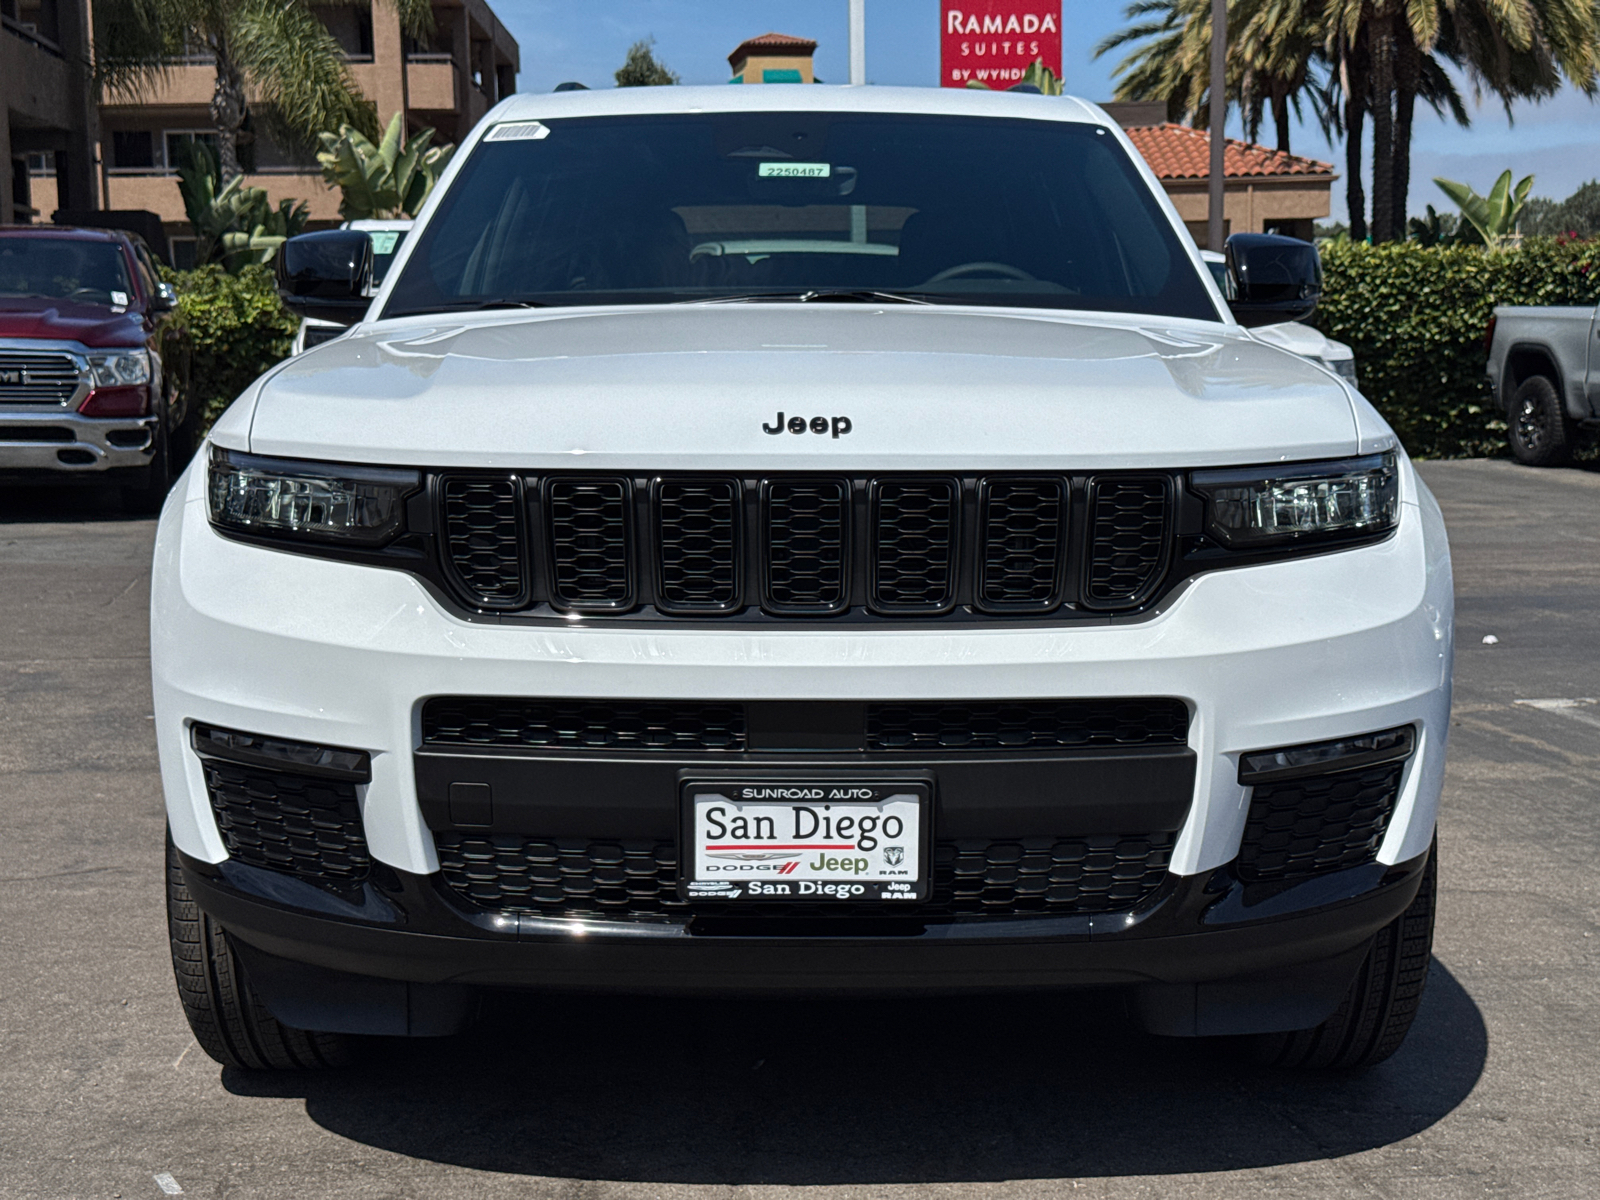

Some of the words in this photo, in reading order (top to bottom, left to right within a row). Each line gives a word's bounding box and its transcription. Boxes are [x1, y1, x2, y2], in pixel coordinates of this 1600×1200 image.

[947, 10, 1057, 34] RAMADA
[961, 41, 1039, 56] SUITES
[952, 68, 971, 81] BY
[767, 167, 824, 176] 2250487
[762, 412, 853, 439] Jeep
[742, 788, 824, 799] SUNROAD
[829, 788, 873, 799] AUTO
[705, 807, 777, 840] San
[792, 804, 904, 851] Diego
[706, 864, 787, 872] DODGE
[810, 853, 869, 875] Jeep
[748, 881, 791, 895] San
[798, 881, 865, 899] Diego
[887, 882, 911, 892] Jeep
